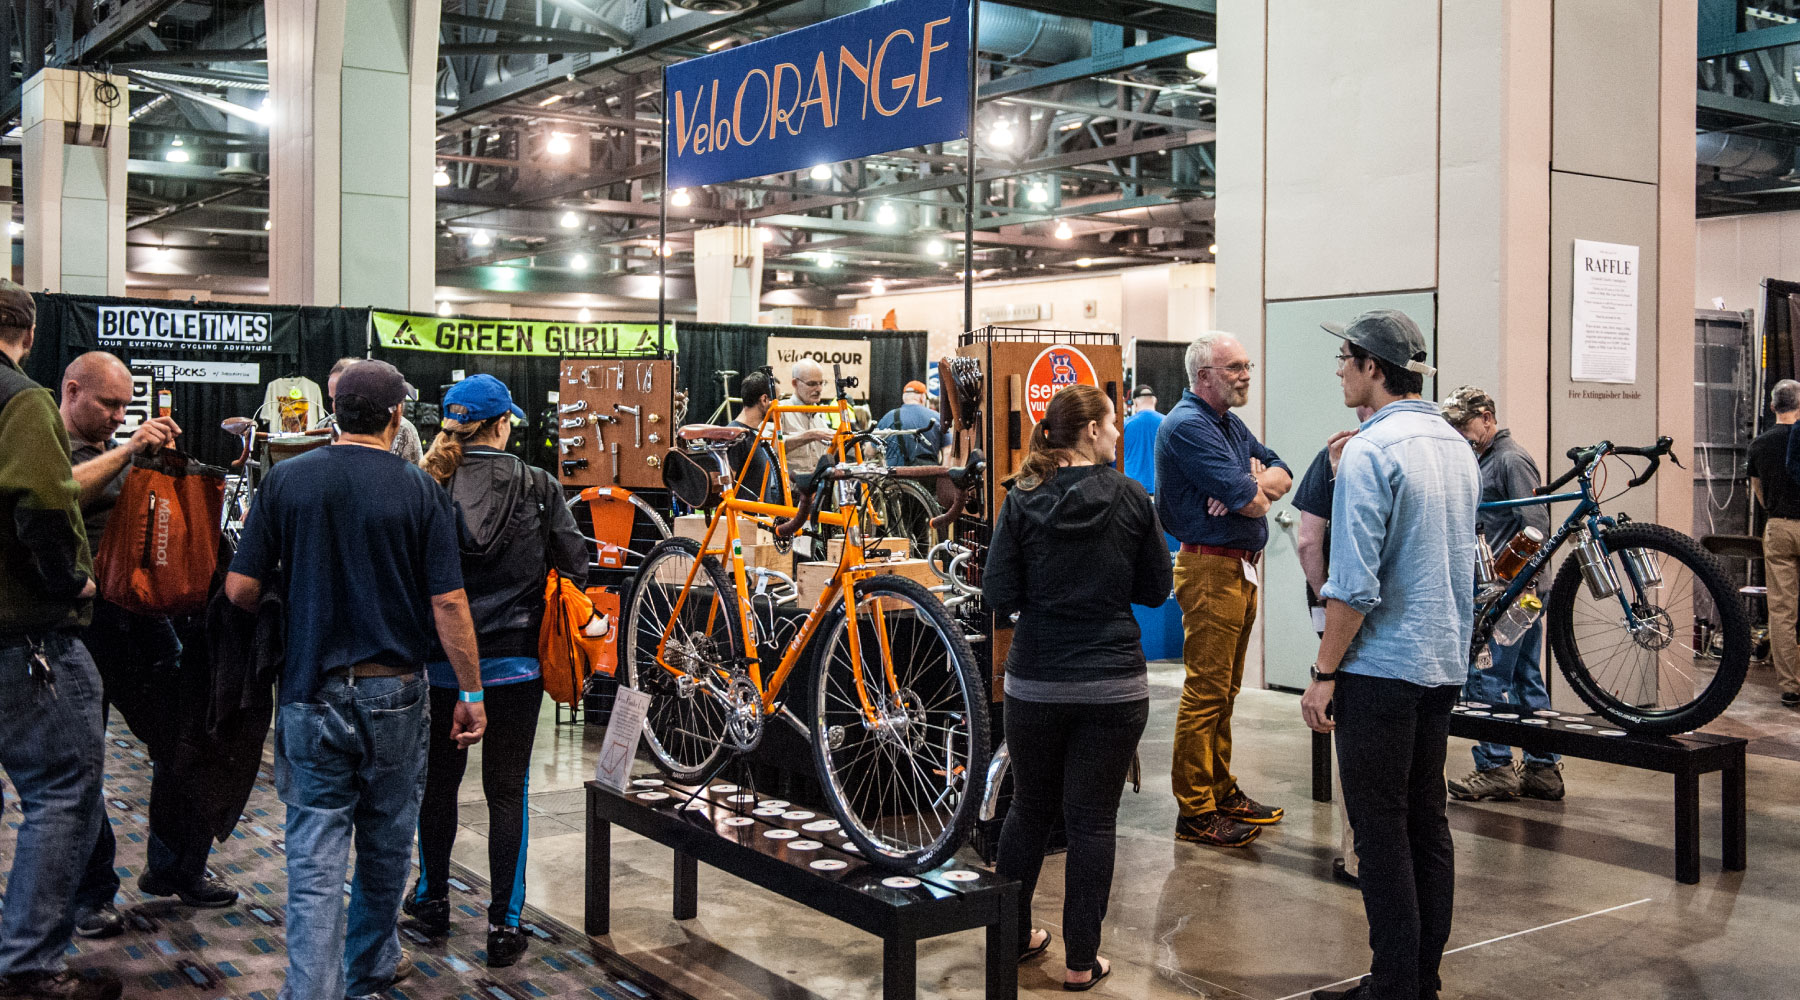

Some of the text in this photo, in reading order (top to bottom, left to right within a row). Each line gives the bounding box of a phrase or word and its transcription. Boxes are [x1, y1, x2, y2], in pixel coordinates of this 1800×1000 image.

[1585, 257, 1632, 276] RAFFLE
[435, 322, 618, 353] GREEN GURU
[129, 341, 174, 349] EVERYDAY
[181, 343, 218, 351] CYCLING
[224, 344, 273, 352] ADVENTURE
[172, 366, 206, 377] SOCKS
[1030, 382, 1074, 399] ser
[1568, 389, 1641, 401] Fire Extinguisher Inside
[156, 497, 171, 566] Marmot
